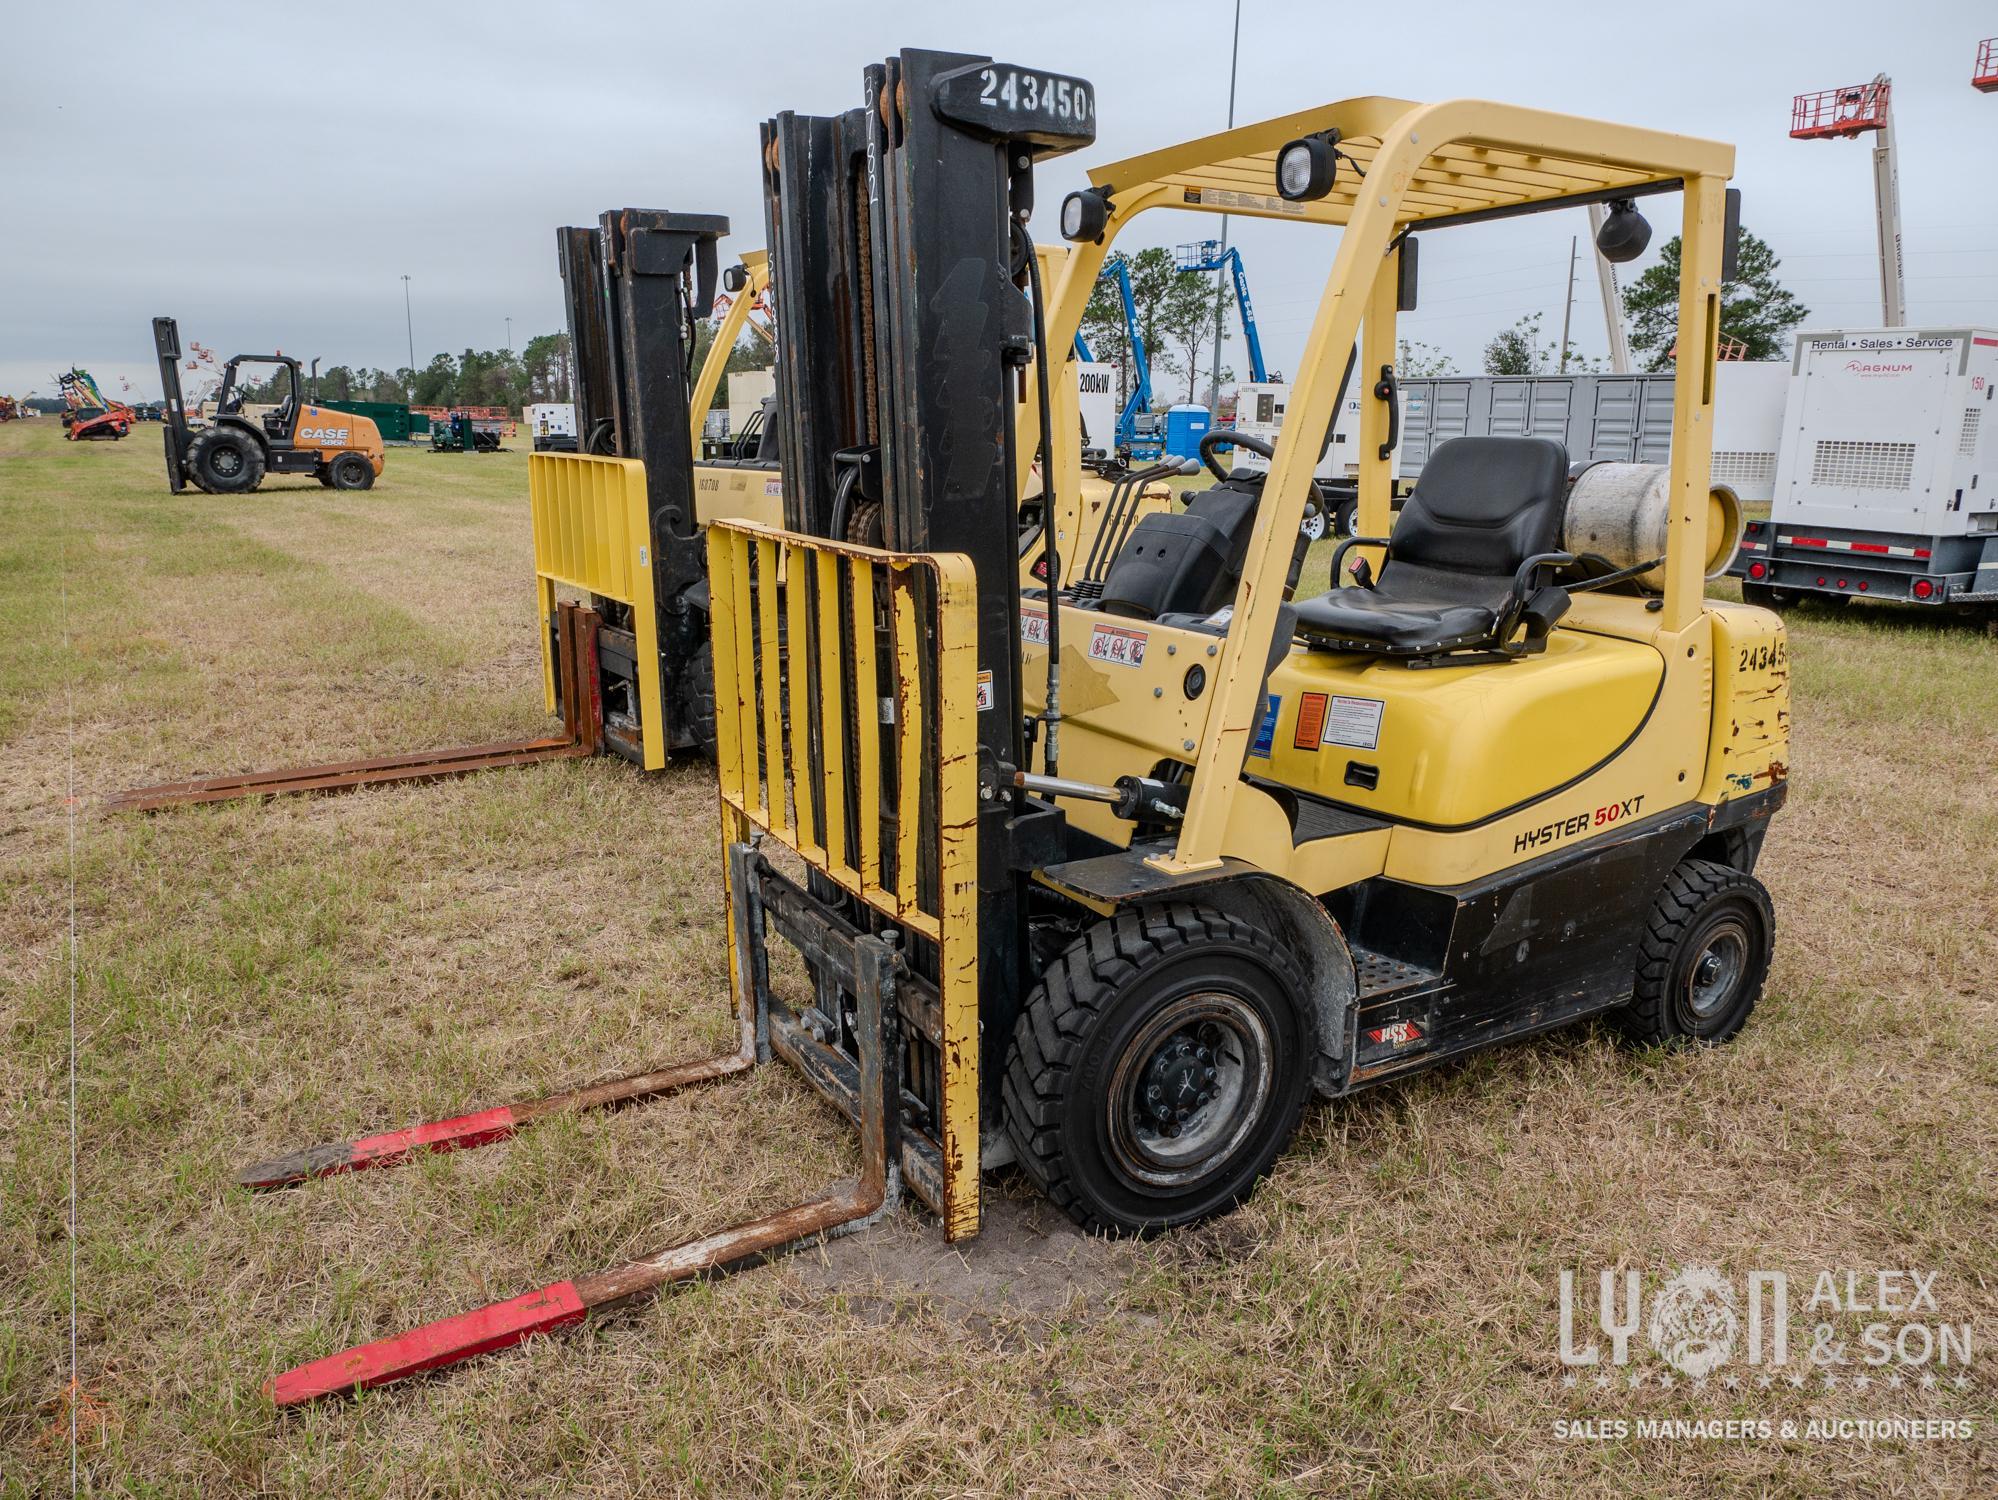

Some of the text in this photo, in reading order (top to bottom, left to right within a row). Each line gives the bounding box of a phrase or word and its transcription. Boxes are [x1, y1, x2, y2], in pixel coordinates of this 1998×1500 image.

[1238, 271, 1248, 297] Genie
[1811, 338, 1953, 350] Rental Sales Service
[1080, 373, 1110, 394] 200kW
[1972, 377, 1985, 390] 150
[300, 428, 349, 439] CASE
[1739, 637, 1787, 673] 24345
[1513, 794, 1645, 854] HYSTER 50XT
